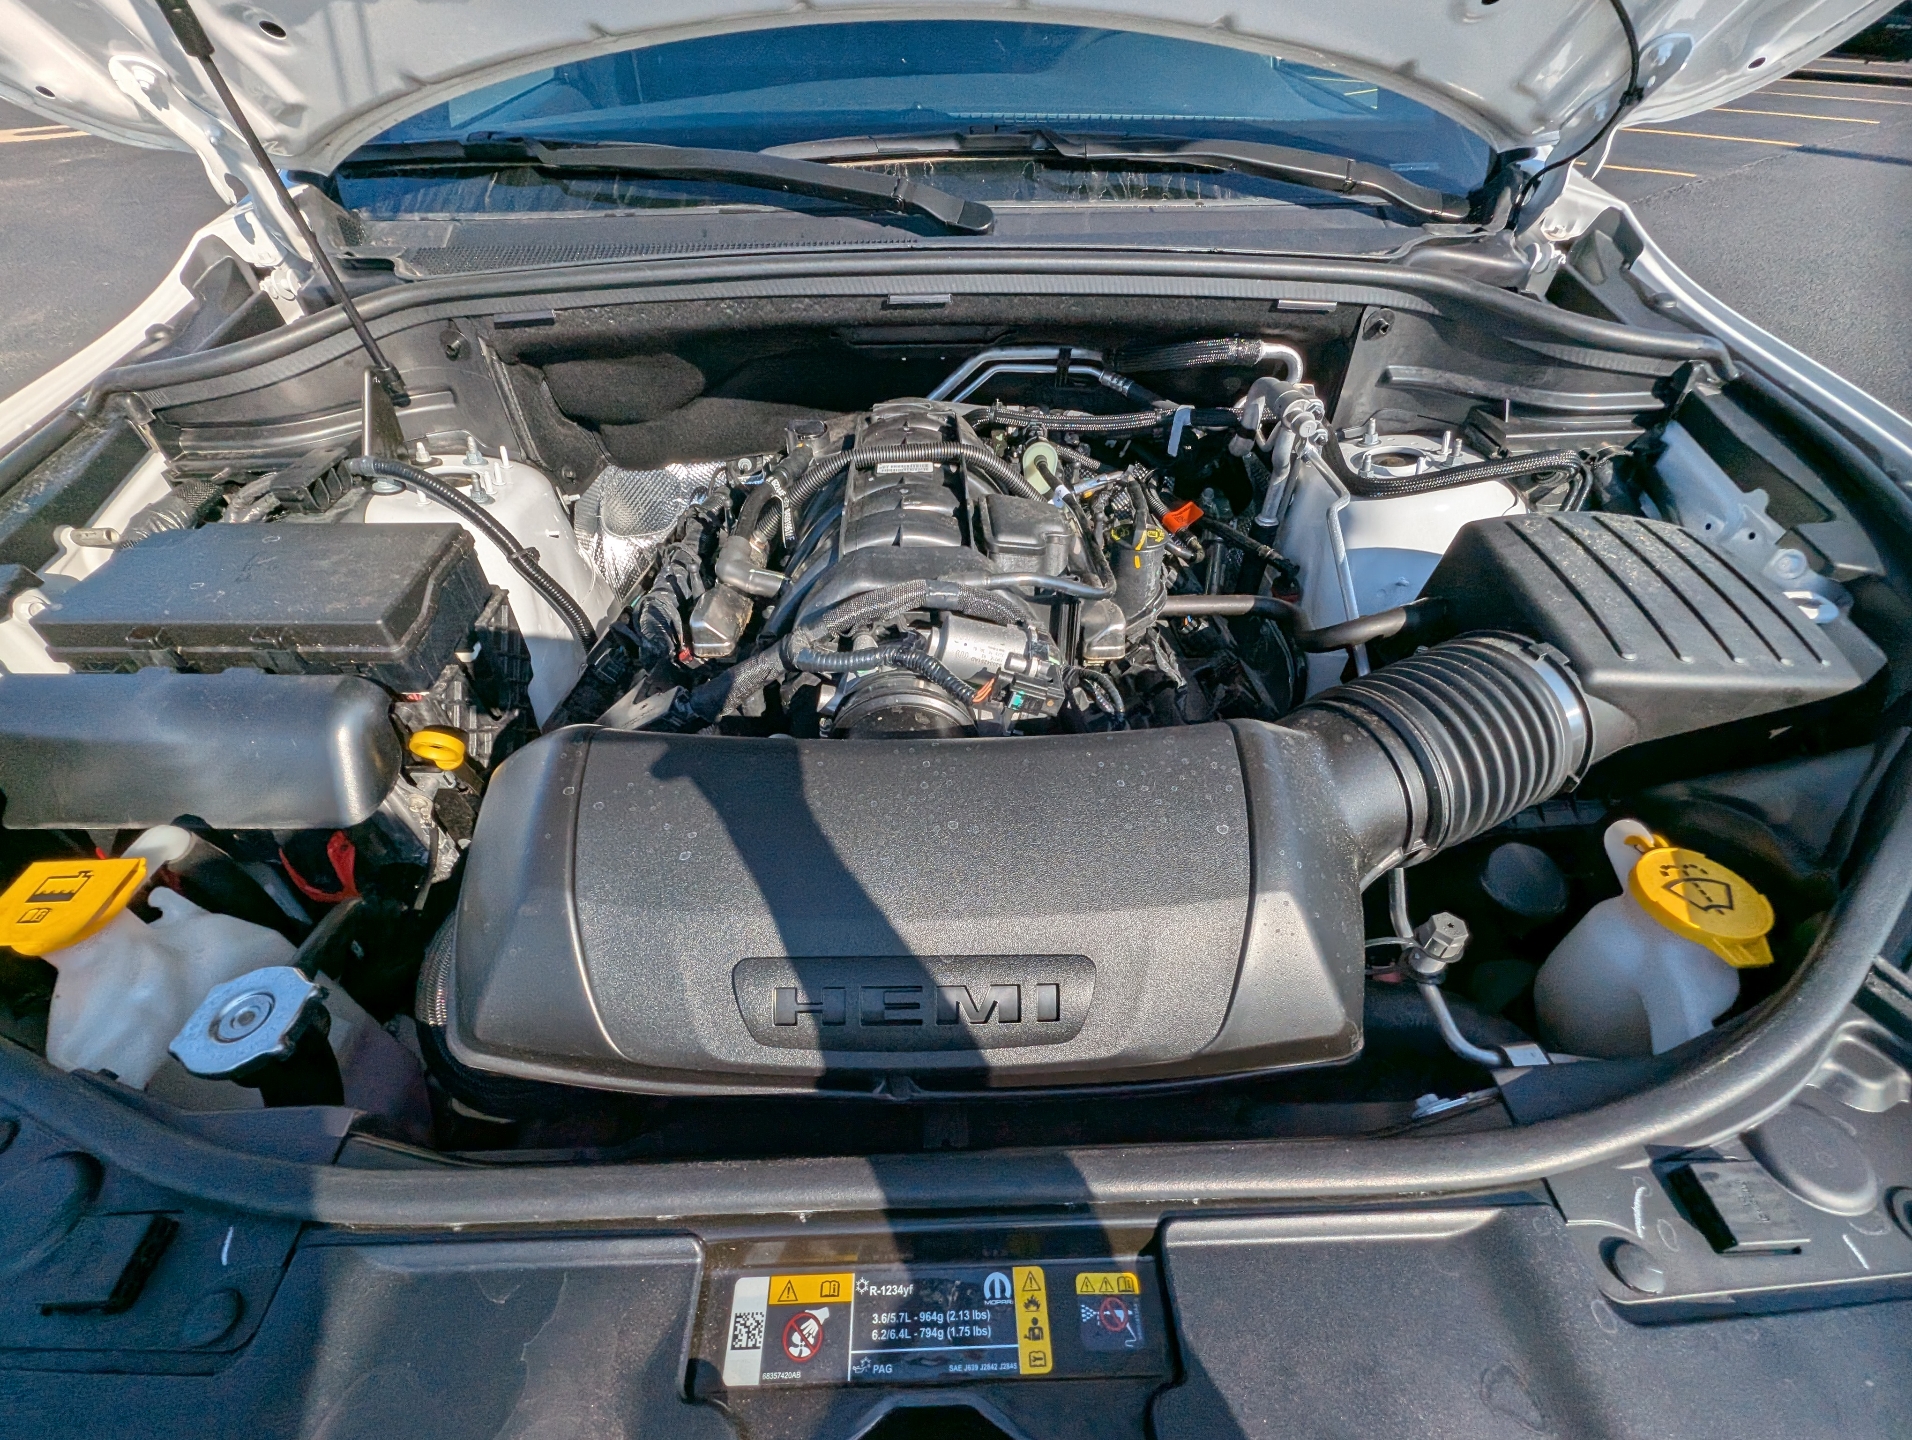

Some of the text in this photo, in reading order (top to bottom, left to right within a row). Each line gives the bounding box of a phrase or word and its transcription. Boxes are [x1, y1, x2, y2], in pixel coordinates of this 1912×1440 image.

[773, 983, 1060, 1026] HEMI
[869, 1284, 914, 1297] R-1234yf
[872, 1312, 911, 1324] 3.6/5.7L
[919, 1311, 944, 1324] 964g
[946, 1310, 970, 1323] (2.13
[972, 1309, 991, 1322] lbs)
[871, 1328, 911, 1341] 6.2/6.4L
[919, 1327, 944, 1340] 794g
[947, 1326, 971, 1339] (1.75
[972, 1325, 992, 1338] lbs)
[872, 1364, 893, 1374] PAG
[949, 1364, 963, 1372] SAE
[762, 1371, 801, 1380] 68357420AB
